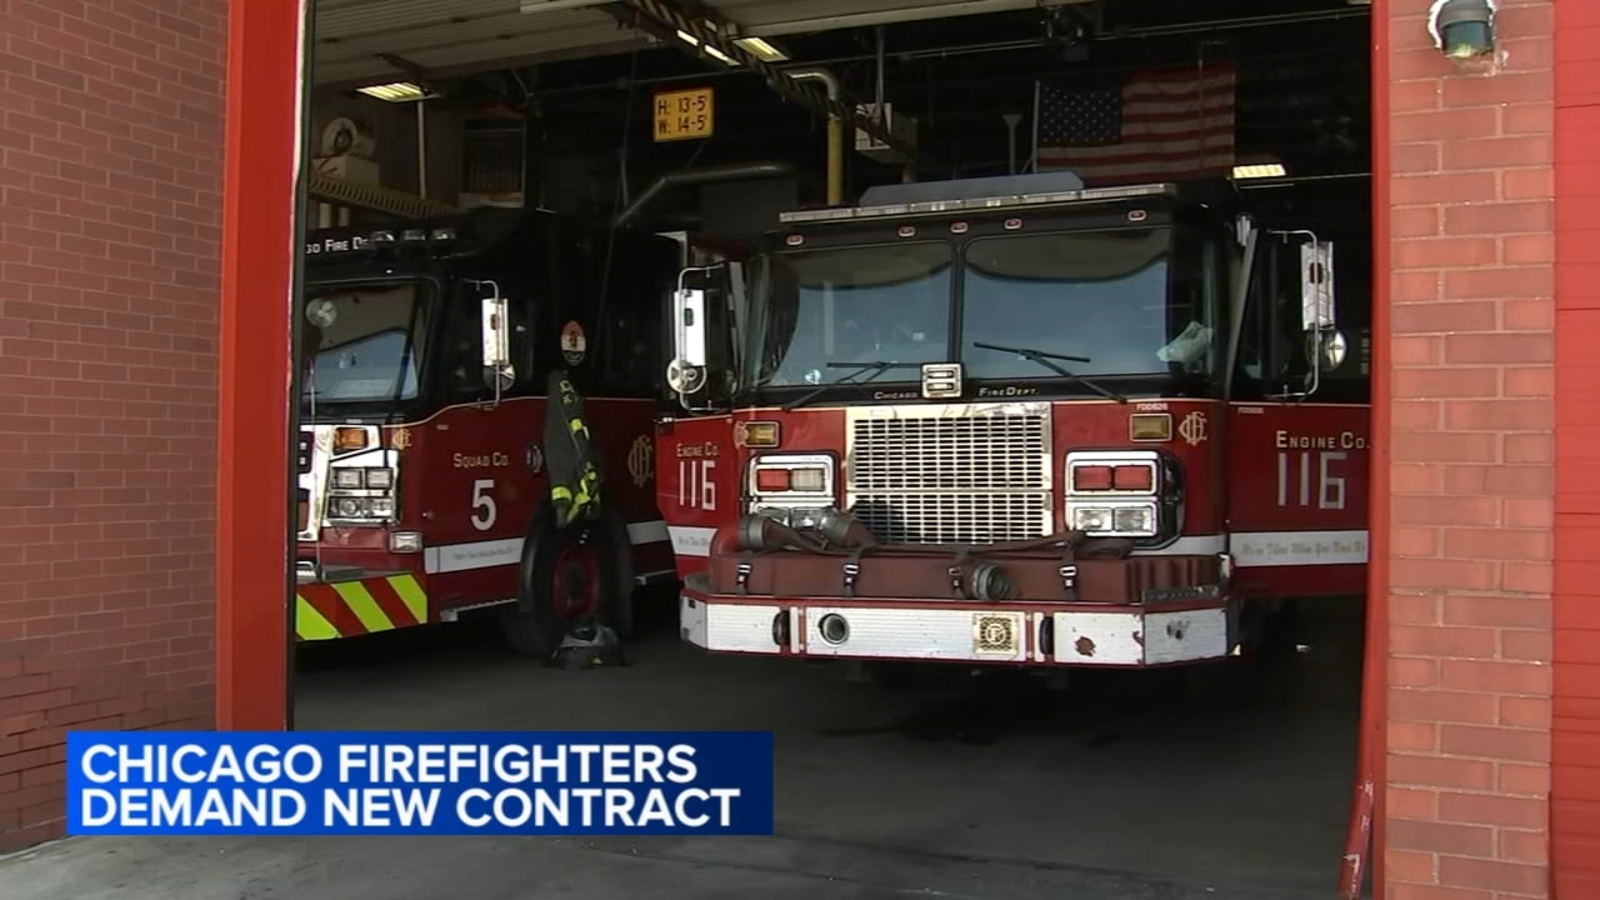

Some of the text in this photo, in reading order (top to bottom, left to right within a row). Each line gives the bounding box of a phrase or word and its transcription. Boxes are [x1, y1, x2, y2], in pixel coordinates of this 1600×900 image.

[325, 239, 349, 252] FIRE
[1275, 429, 1336, 449] ENGINE
[453, 452, 490, 469] SQUAD
[679, 459, 717, 511] 116
[1277, 451, 1347, 510] 116
[471, 479, 497, 531] 5
